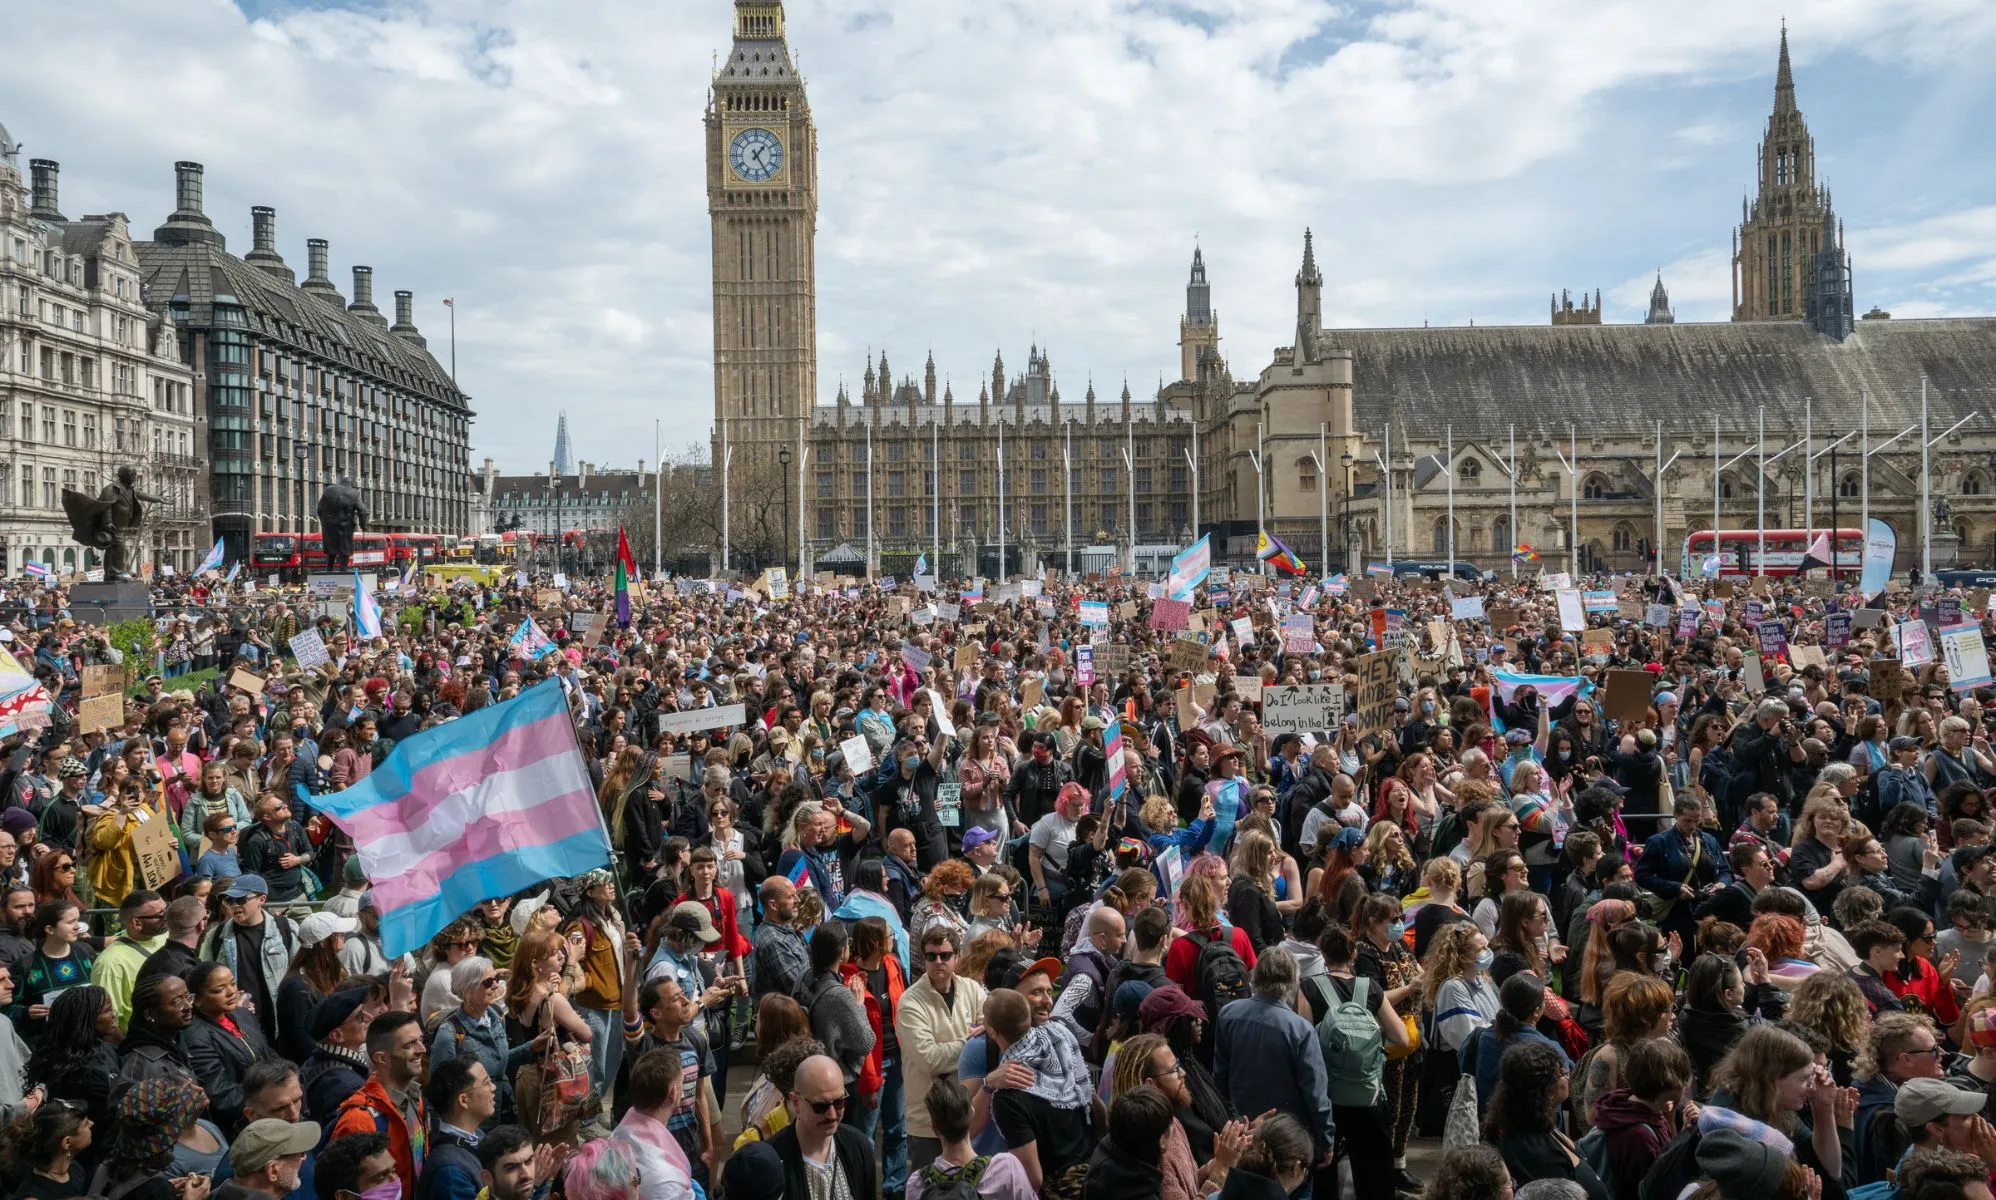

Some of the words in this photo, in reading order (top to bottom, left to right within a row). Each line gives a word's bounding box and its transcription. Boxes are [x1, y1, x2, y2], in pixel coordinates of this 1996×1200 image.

[1827, 618, 1845, 627] Trans
[1759, 626, 1779, 634] Trans
[1828, 626, 1849, 637] Rights
[1761, 633, 1786, 645] Rights
[1828, 636, 1843, 645] Now
[1762, 643, 1780, 652] Now
[1077, 651, 1090, 660] Trans
[1079, 660, 1093, 672] Rights
[1359, 653, 1399, 684] HEY,
[1078, 672, 1089, 681] Now
[1266, 692, 1279, 707] Do
[1280, 694, 1289, 707] I
[1293, 695, 1313, 706] look
[1314, 693, 1331, 704] like
[1332, 694, 1342, 705] I
[1359, 680, 1394, 707] MAYBE
[1264, 713, 1297, 733] belong
[1298, 717, 1308, 728] in
[1308, 716, 1322, 728] the
[142, 853, 153, 869] MY
[146, 870, 159, 889] NOT
